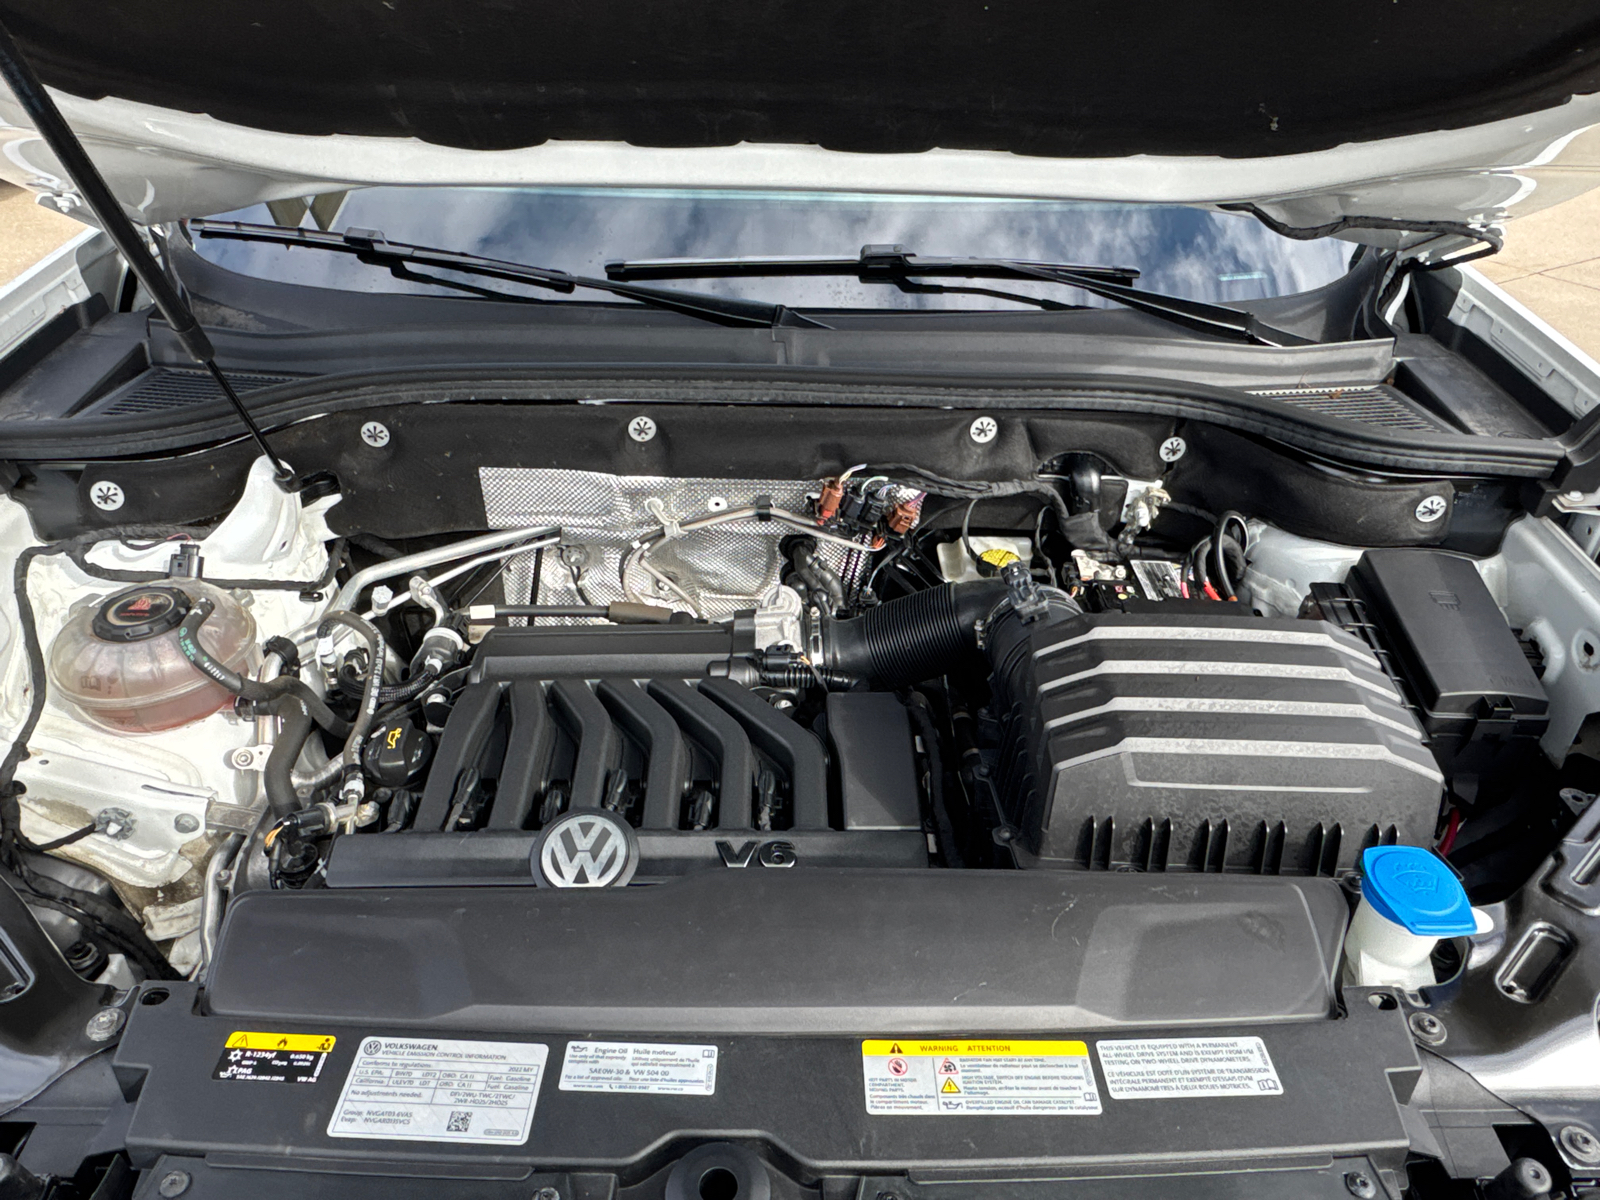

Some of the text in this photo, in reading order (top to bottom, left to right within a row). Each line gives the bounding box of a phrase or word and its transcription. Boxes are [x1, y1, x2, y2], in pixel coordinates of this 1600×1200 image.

[715, 840, 797, 867] V6
[384, 1042, 438, 1051] VOLKSWAGEN
[594, 1047, 617, 1055] Engine
